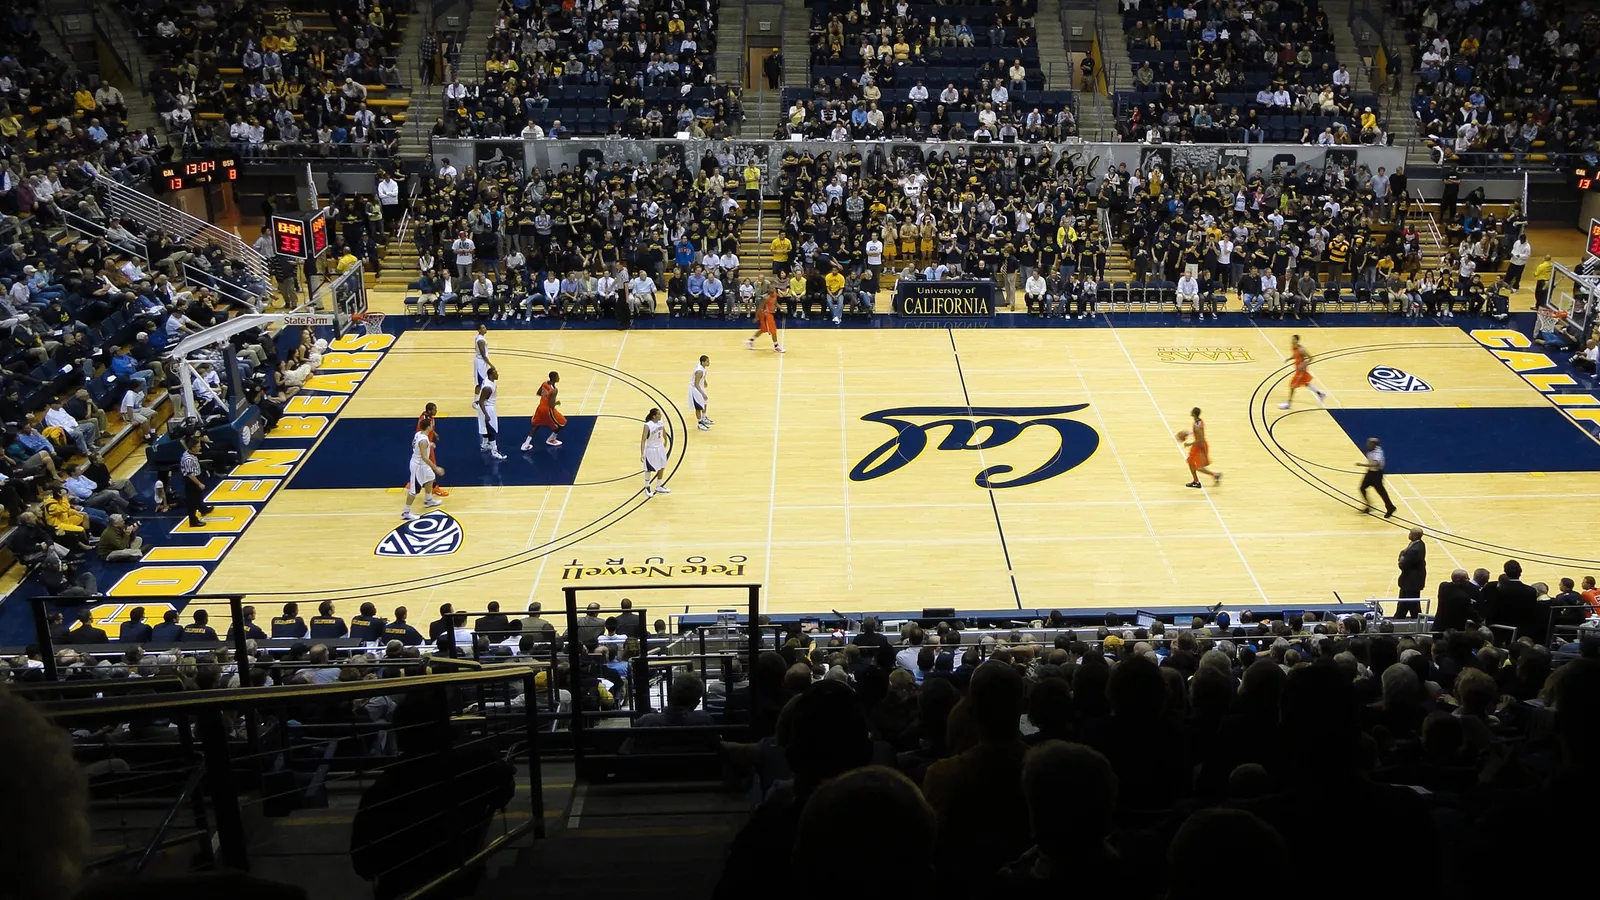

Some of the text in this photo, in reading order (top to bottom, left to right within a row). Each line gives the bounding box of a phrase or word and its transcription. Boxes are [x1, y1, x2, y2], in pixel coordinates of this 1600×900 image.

[162, 169, 175, 177] CAL
[186, 160, 215, 175] 13:04
[229, 169, 237, 180] 8
[171, 178, 182, 190] 13
[1578, 179, 1591, 190] 13
[917, 286, 977, 296] University of
[903, 297, 989, 315] CALIFORNIA
[1157, 350, 1256, 361] HAAS
[264, 333, 396, 439] BEARS
[848, 402, 1100, 489] Cal
[69, 448, 307, 640] GOLDEN
[563, 555, 748, 567] COURT
[561, 564, 748, 580] Pete Newell
